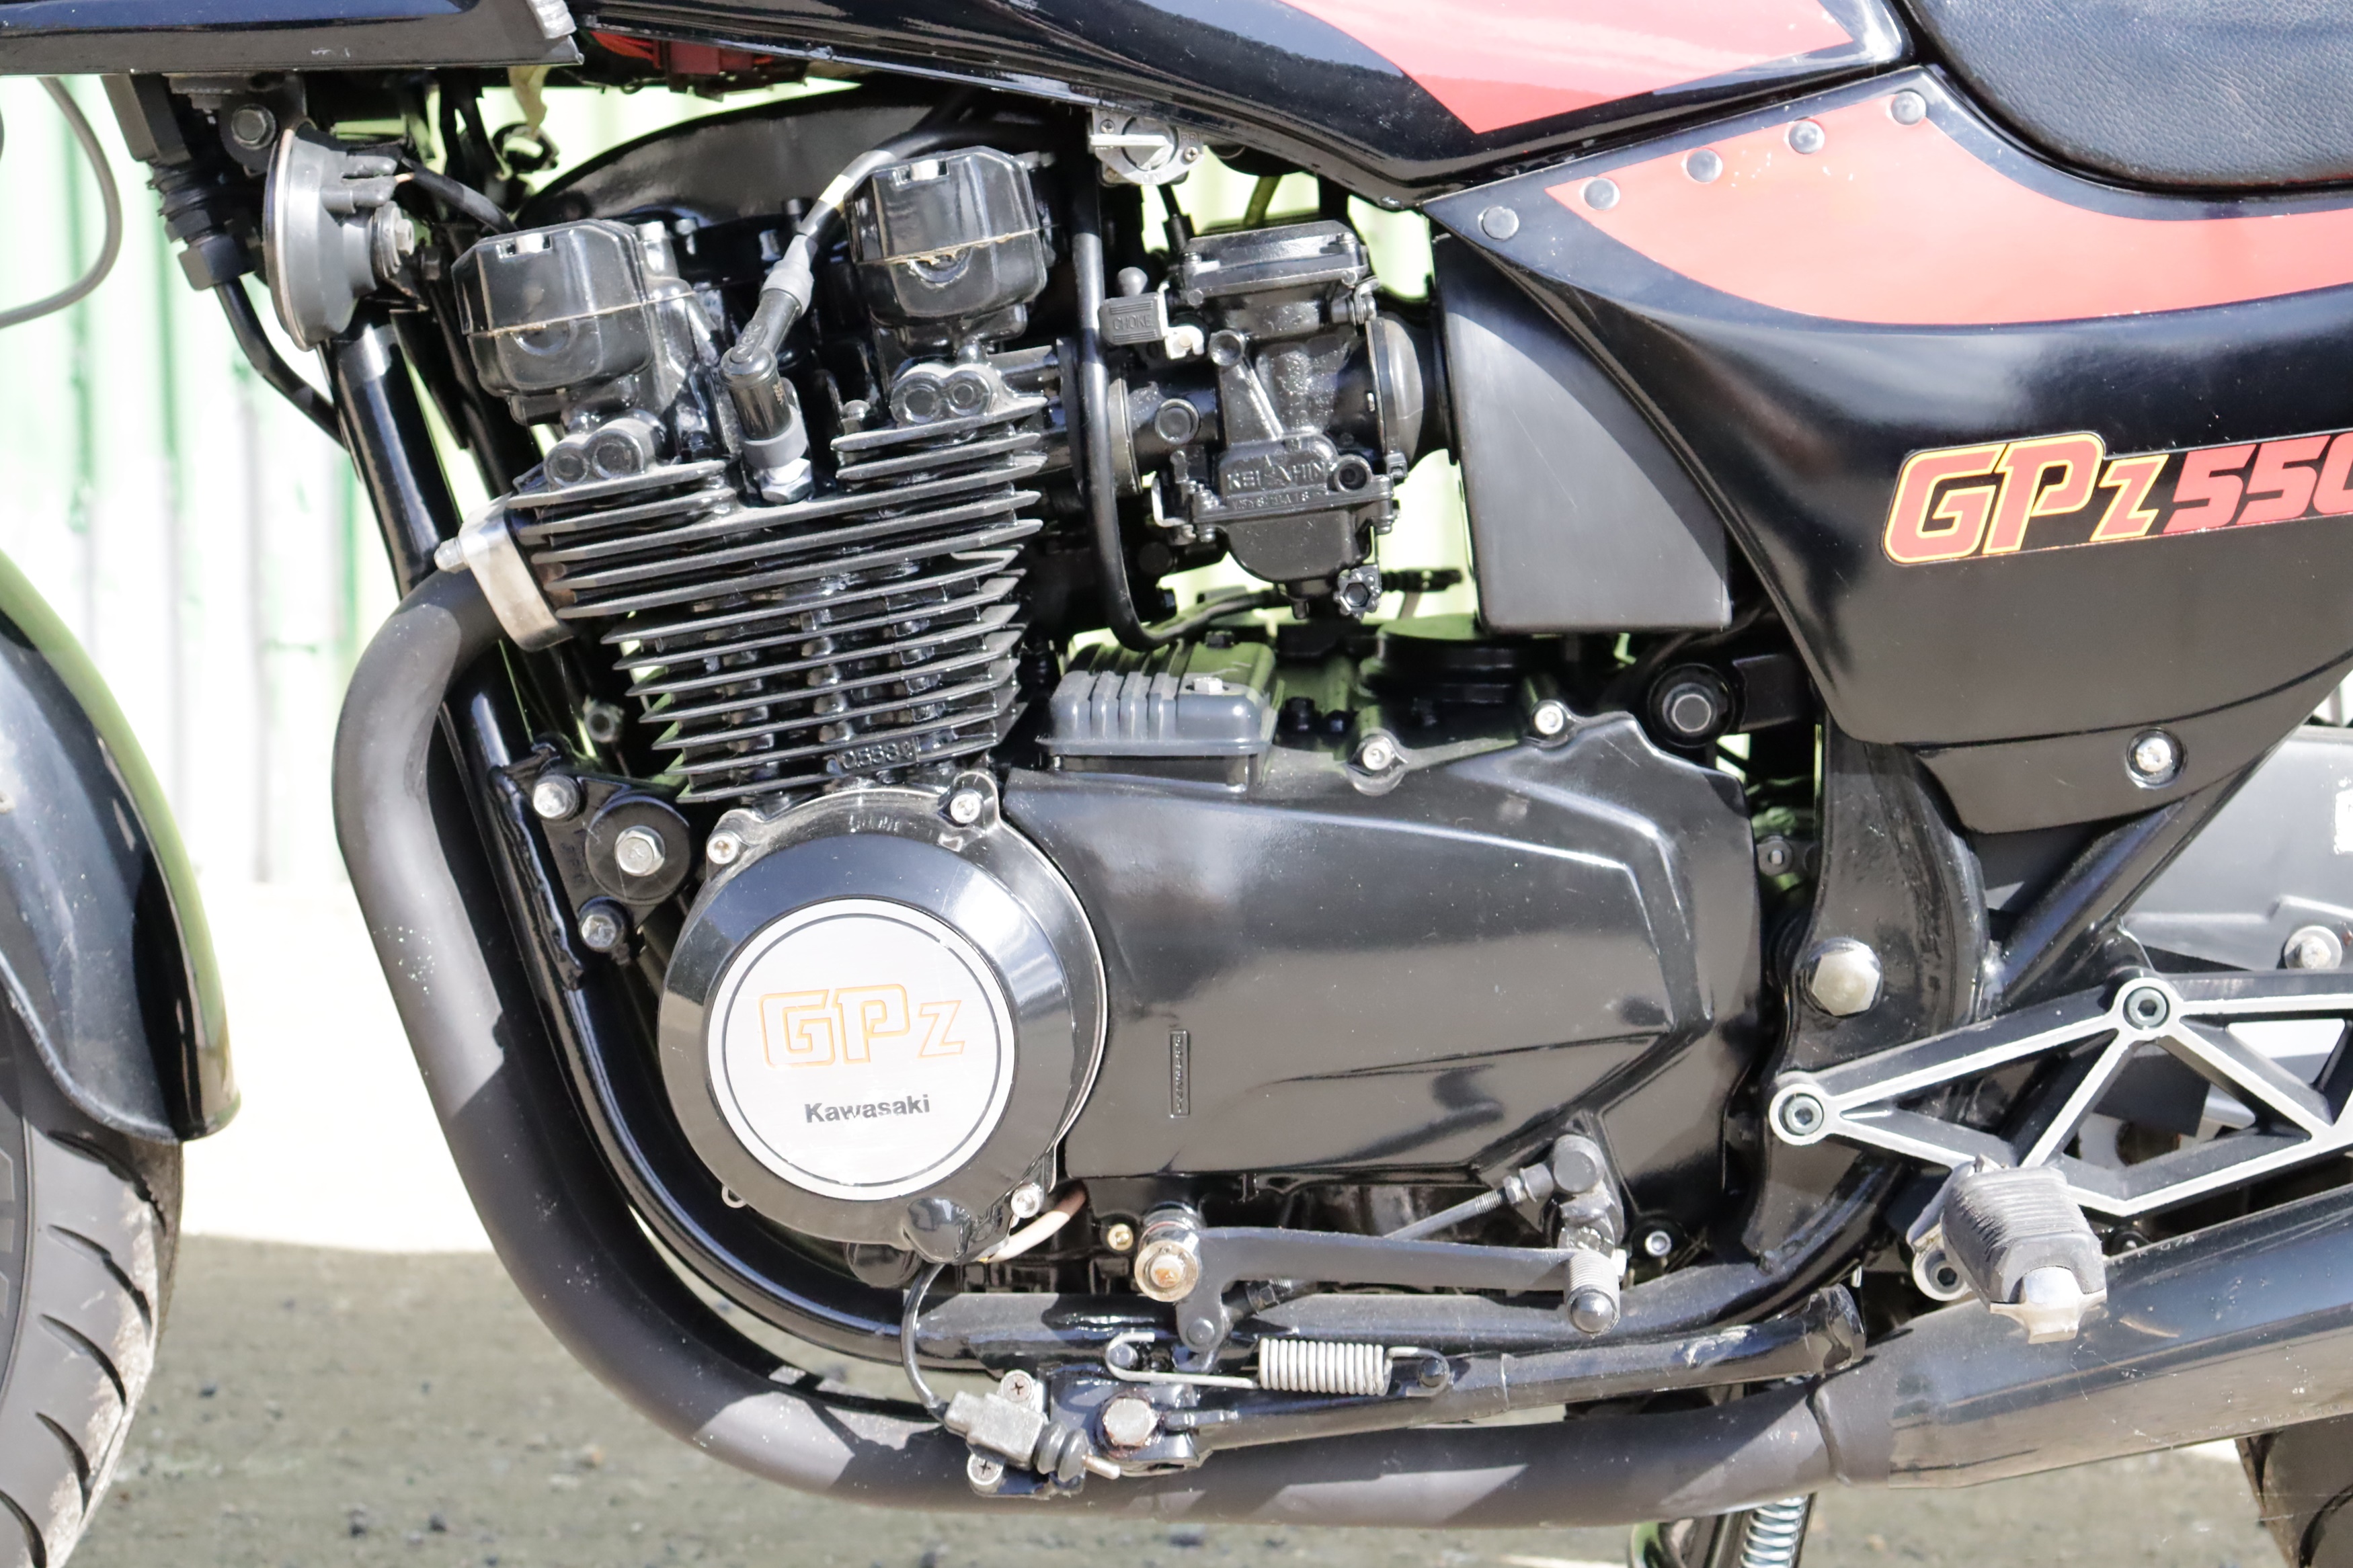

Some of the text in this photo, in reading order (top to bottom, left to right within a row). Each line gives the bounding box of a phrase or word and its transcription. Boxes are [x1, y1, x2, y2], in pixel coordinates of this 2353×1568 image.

[1113, 314, 1154, 331] CHOKE
[1883, 434, 2169, 563] GPz
[758, 984, 965, 1068] GPz
[804, 1094, 930, 1122] Kawasaki
